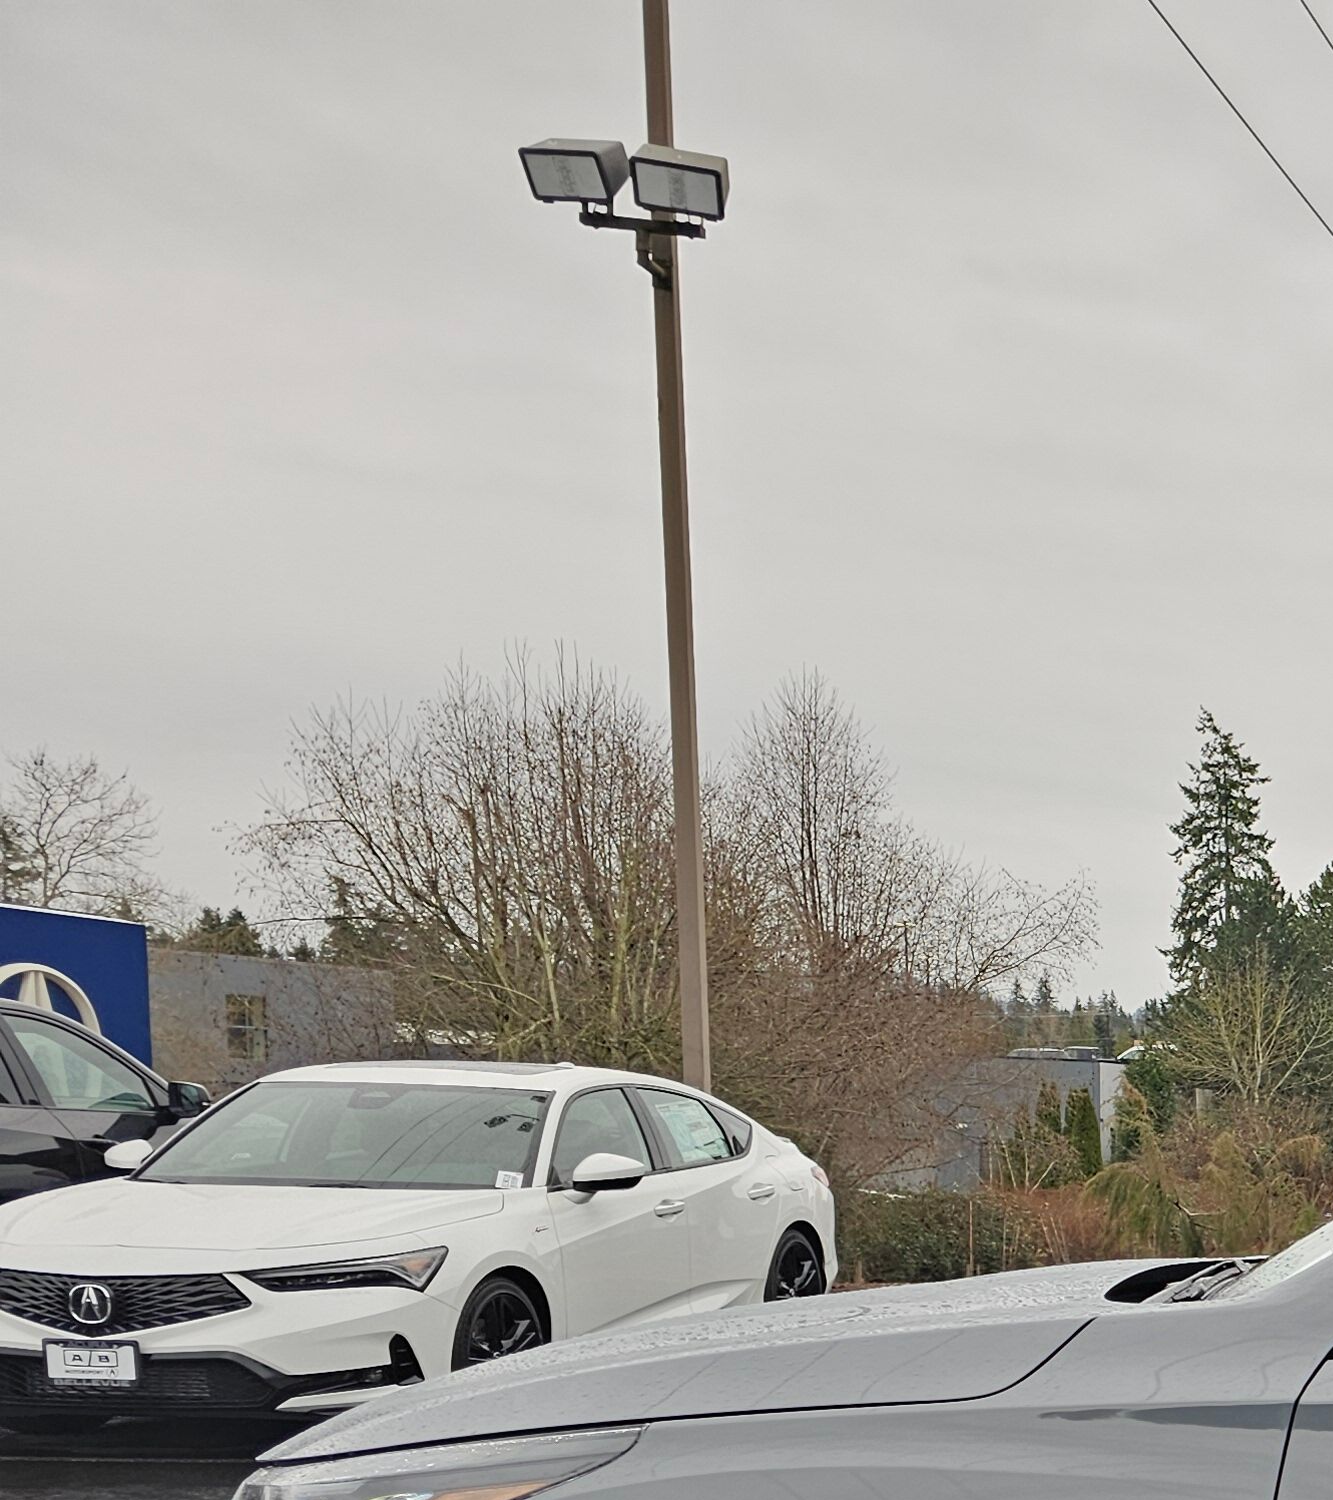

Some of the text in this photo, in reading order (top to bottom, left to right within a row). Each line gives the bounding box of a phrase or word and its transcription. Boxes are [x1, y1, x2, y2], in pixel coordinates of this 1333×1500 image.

[72, 1354, 110, 1363] A B
[53, 1379, 131, 1387] BELLEVUE
